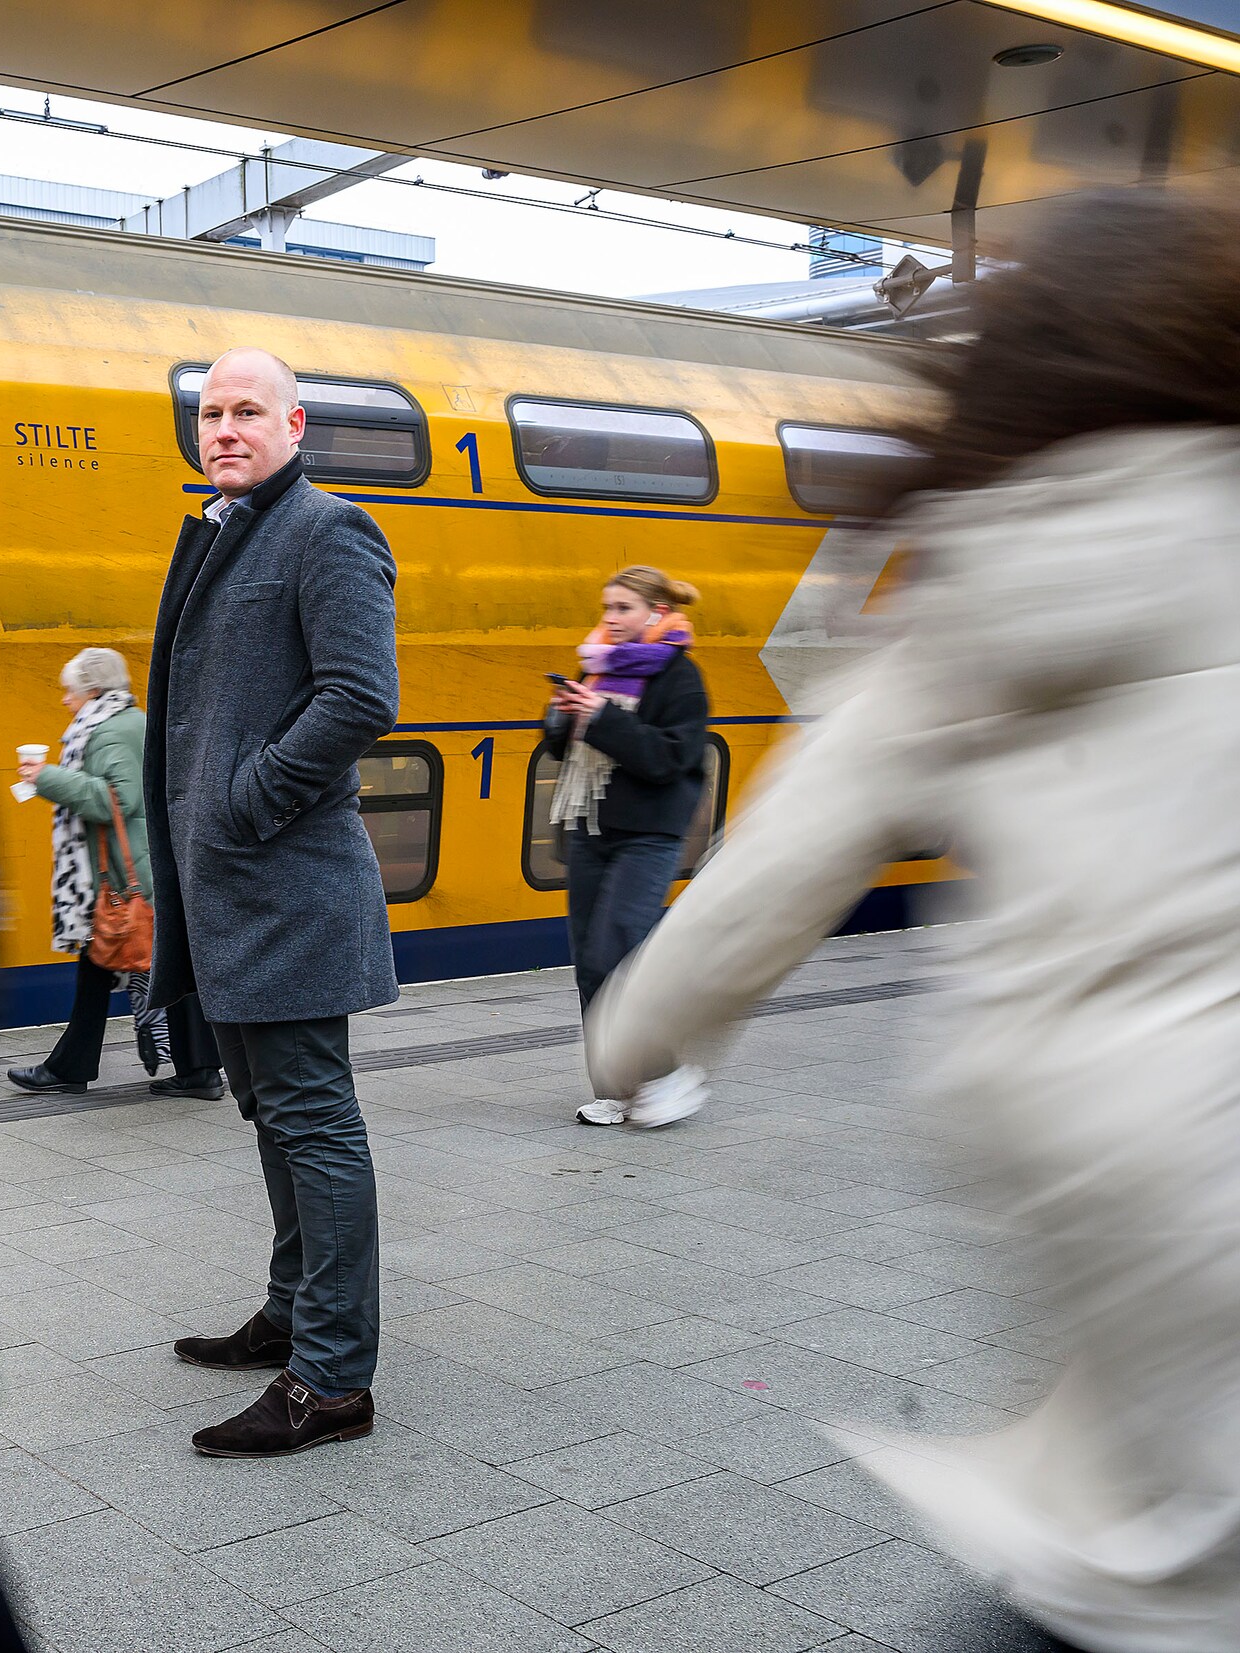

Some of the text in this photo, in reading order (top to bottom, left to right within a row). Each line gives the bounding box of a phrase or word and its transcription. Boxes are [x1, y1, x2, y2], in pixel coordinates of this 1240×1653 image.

[14, 422, 97, 450] STILTE
[17, 453, 99, 470] silence
[455, 432, 483, 494] 1
[471, 736, 495, 799] 1
